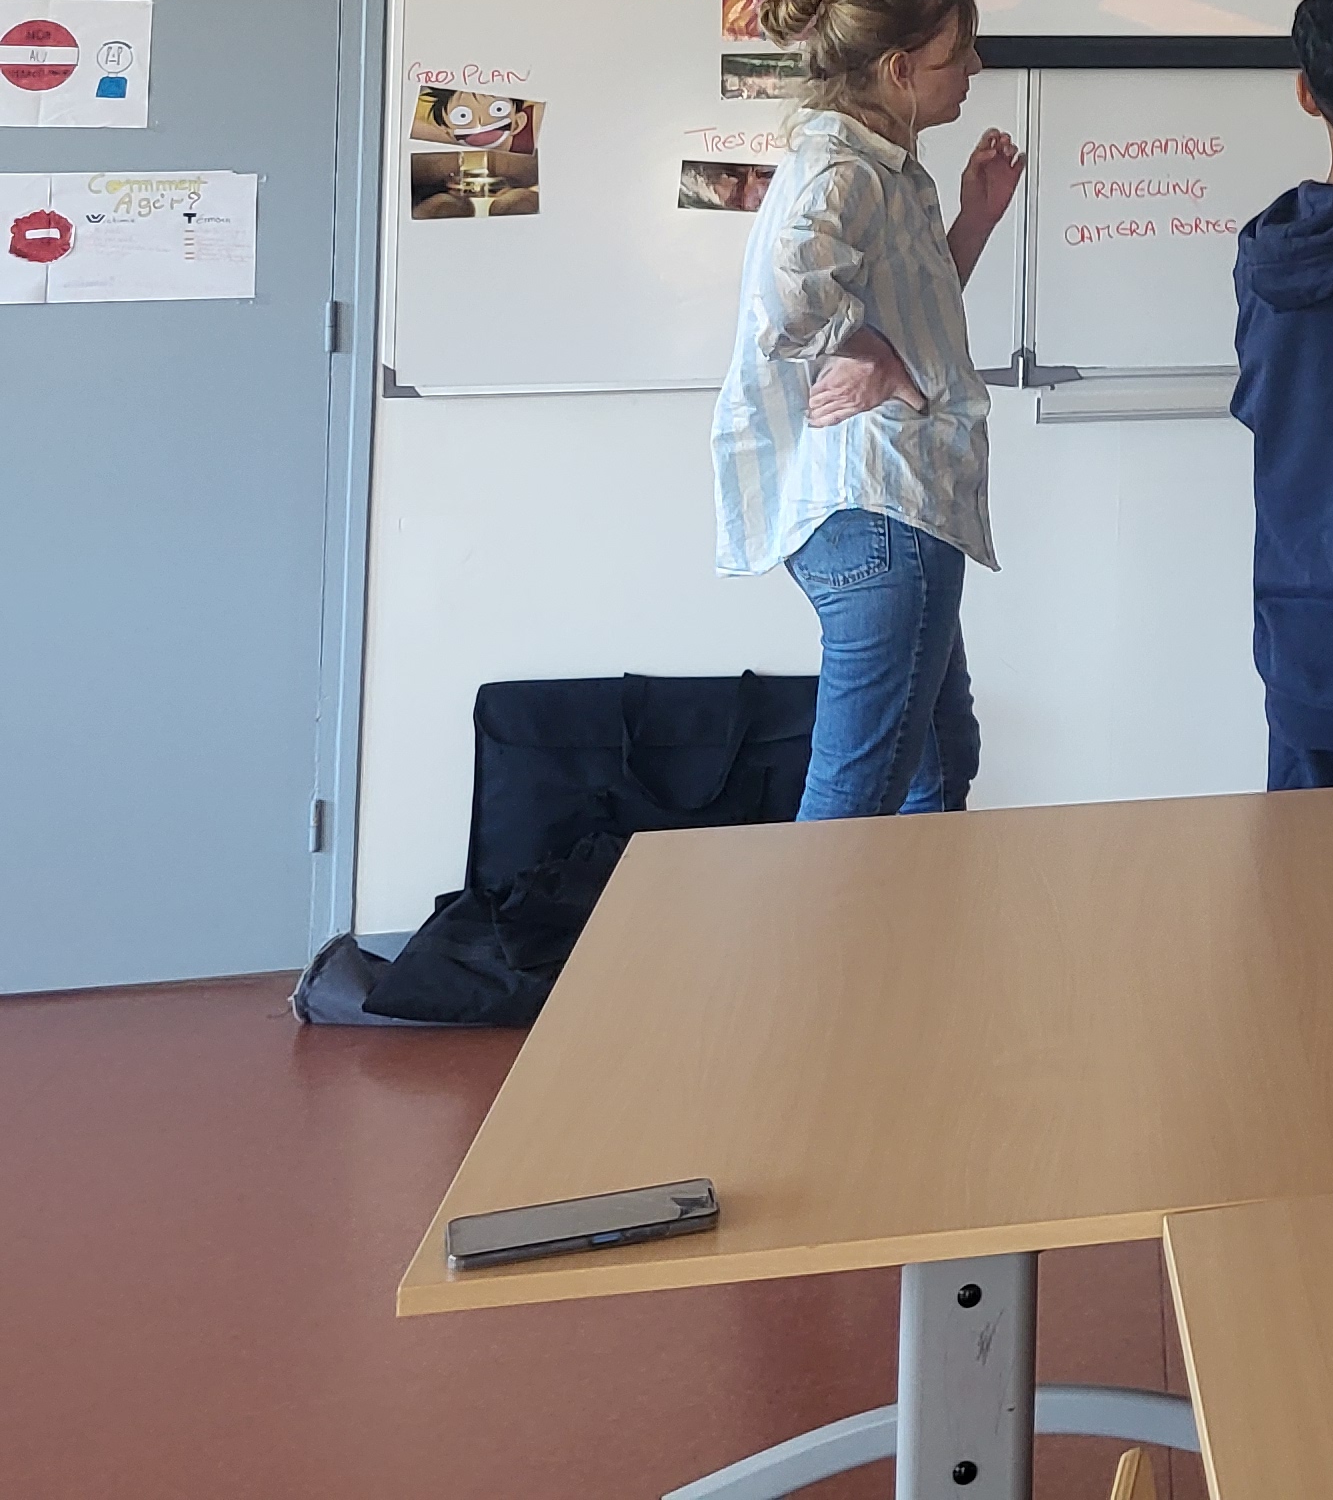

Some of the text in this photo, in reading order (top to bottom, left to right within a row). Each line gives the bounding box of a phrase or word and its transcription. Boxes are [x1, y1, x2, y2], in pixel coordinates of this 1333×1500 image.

[29, 49, 48, 63] AU
[408, 61, 531, 86] GROS PLAN
[684, 127, 745, 153] TRES
[1080, 135, 1225, 166] PANORAMIQUE
[1070, 175, 1208, 199] TRAVELLING
[1064, 219, 1157, 246] CAMERA
